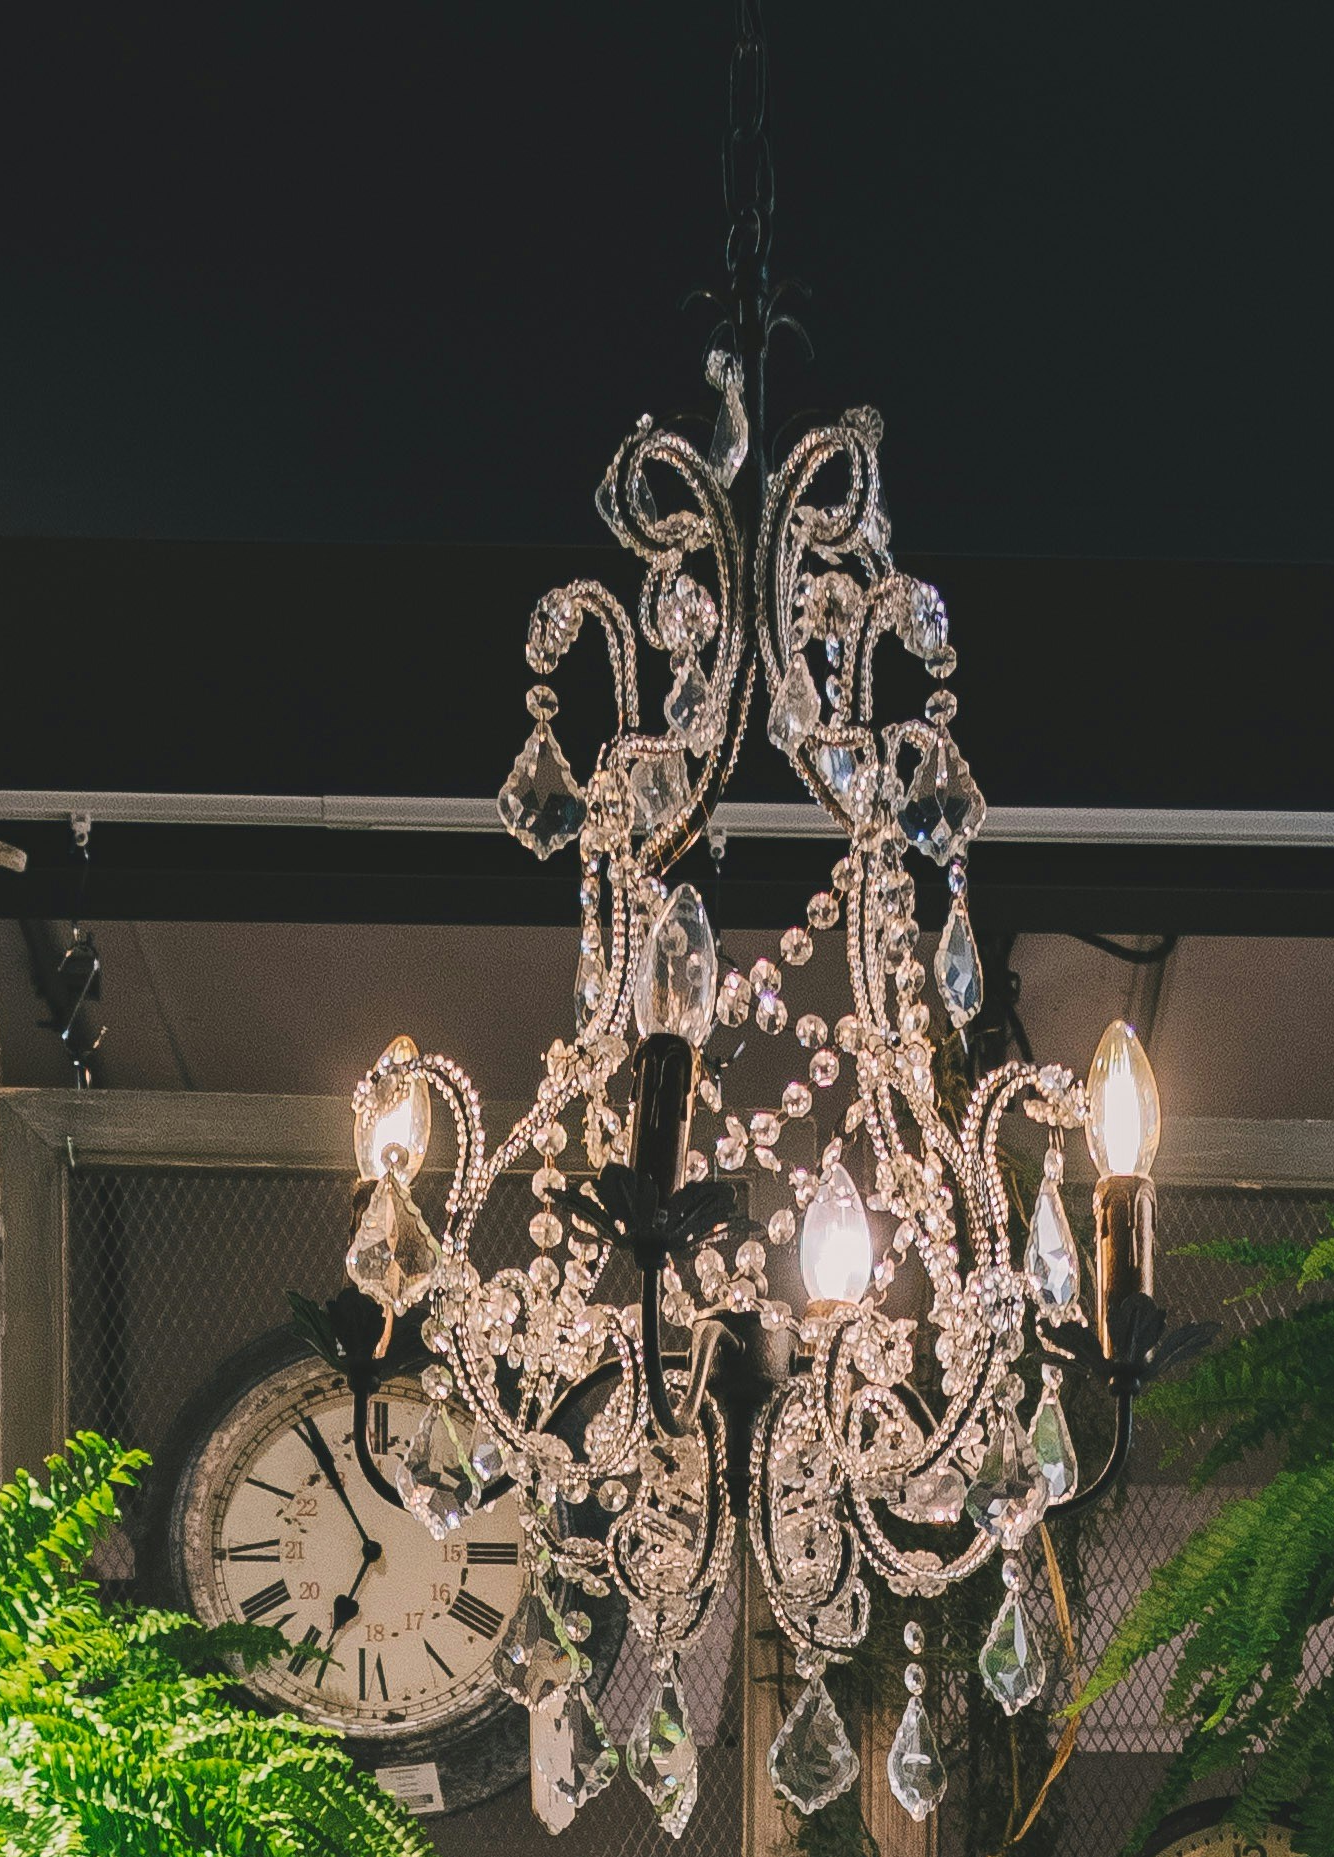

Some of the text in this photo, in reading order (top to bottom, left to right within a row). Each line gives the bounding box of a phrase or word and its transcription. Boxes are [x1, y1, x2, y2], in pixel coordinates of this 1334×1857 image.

[296, 1499, 317, 1517] 22
[285, 1541, 305, 1559] 21
[443, 1544, 463, 1563] 15
[299, 1582, 320, 1600] 20
[430, 1582, 451, 1602] 16
[404, 1612, 424, 1631] 17
[365, 1624, 385, 1642] 18
